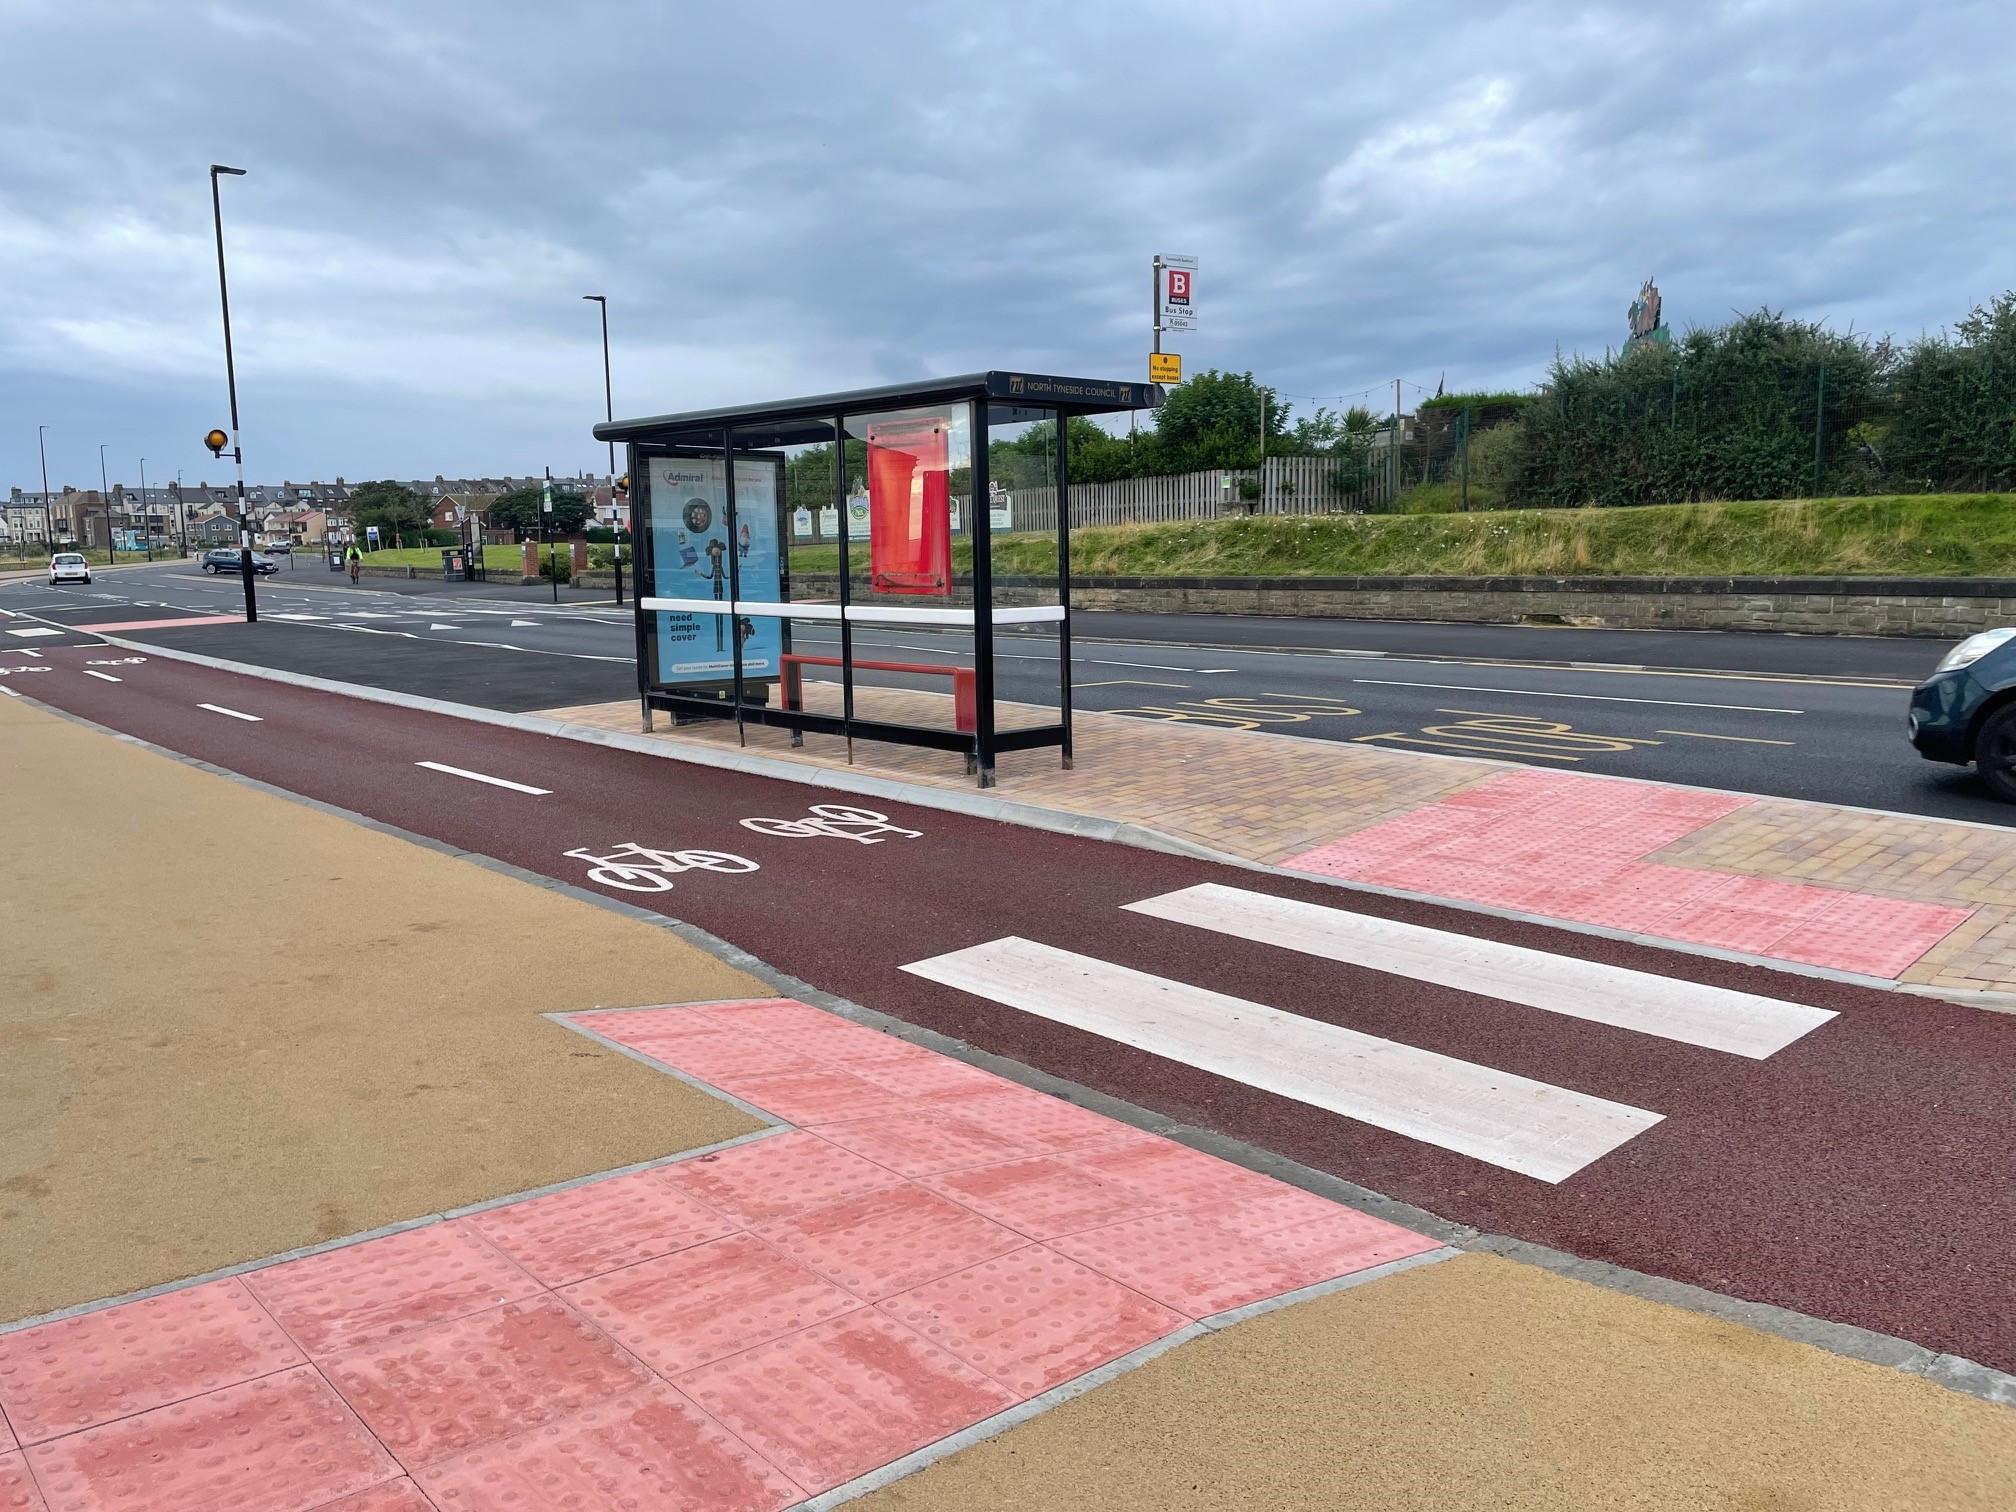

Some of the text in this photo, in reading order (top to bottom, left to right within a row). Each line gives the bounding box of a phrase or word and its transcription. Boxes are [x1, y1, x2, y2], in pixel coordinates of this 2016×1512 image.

[1173, 274, 1186, 294] B
[1165, 306, 1193, 317] Bus Stop
[1027, 381, 1116, 398] NORTH TYNESIDE COUNCIL
[668, 472, 703, 482] Admiral
[670, 613, 692, 621] need
[670, 623, 701, 633] simple
[1098, 697, 1362, 730] BUS
[1351, 718, 1665, 763] TOP
